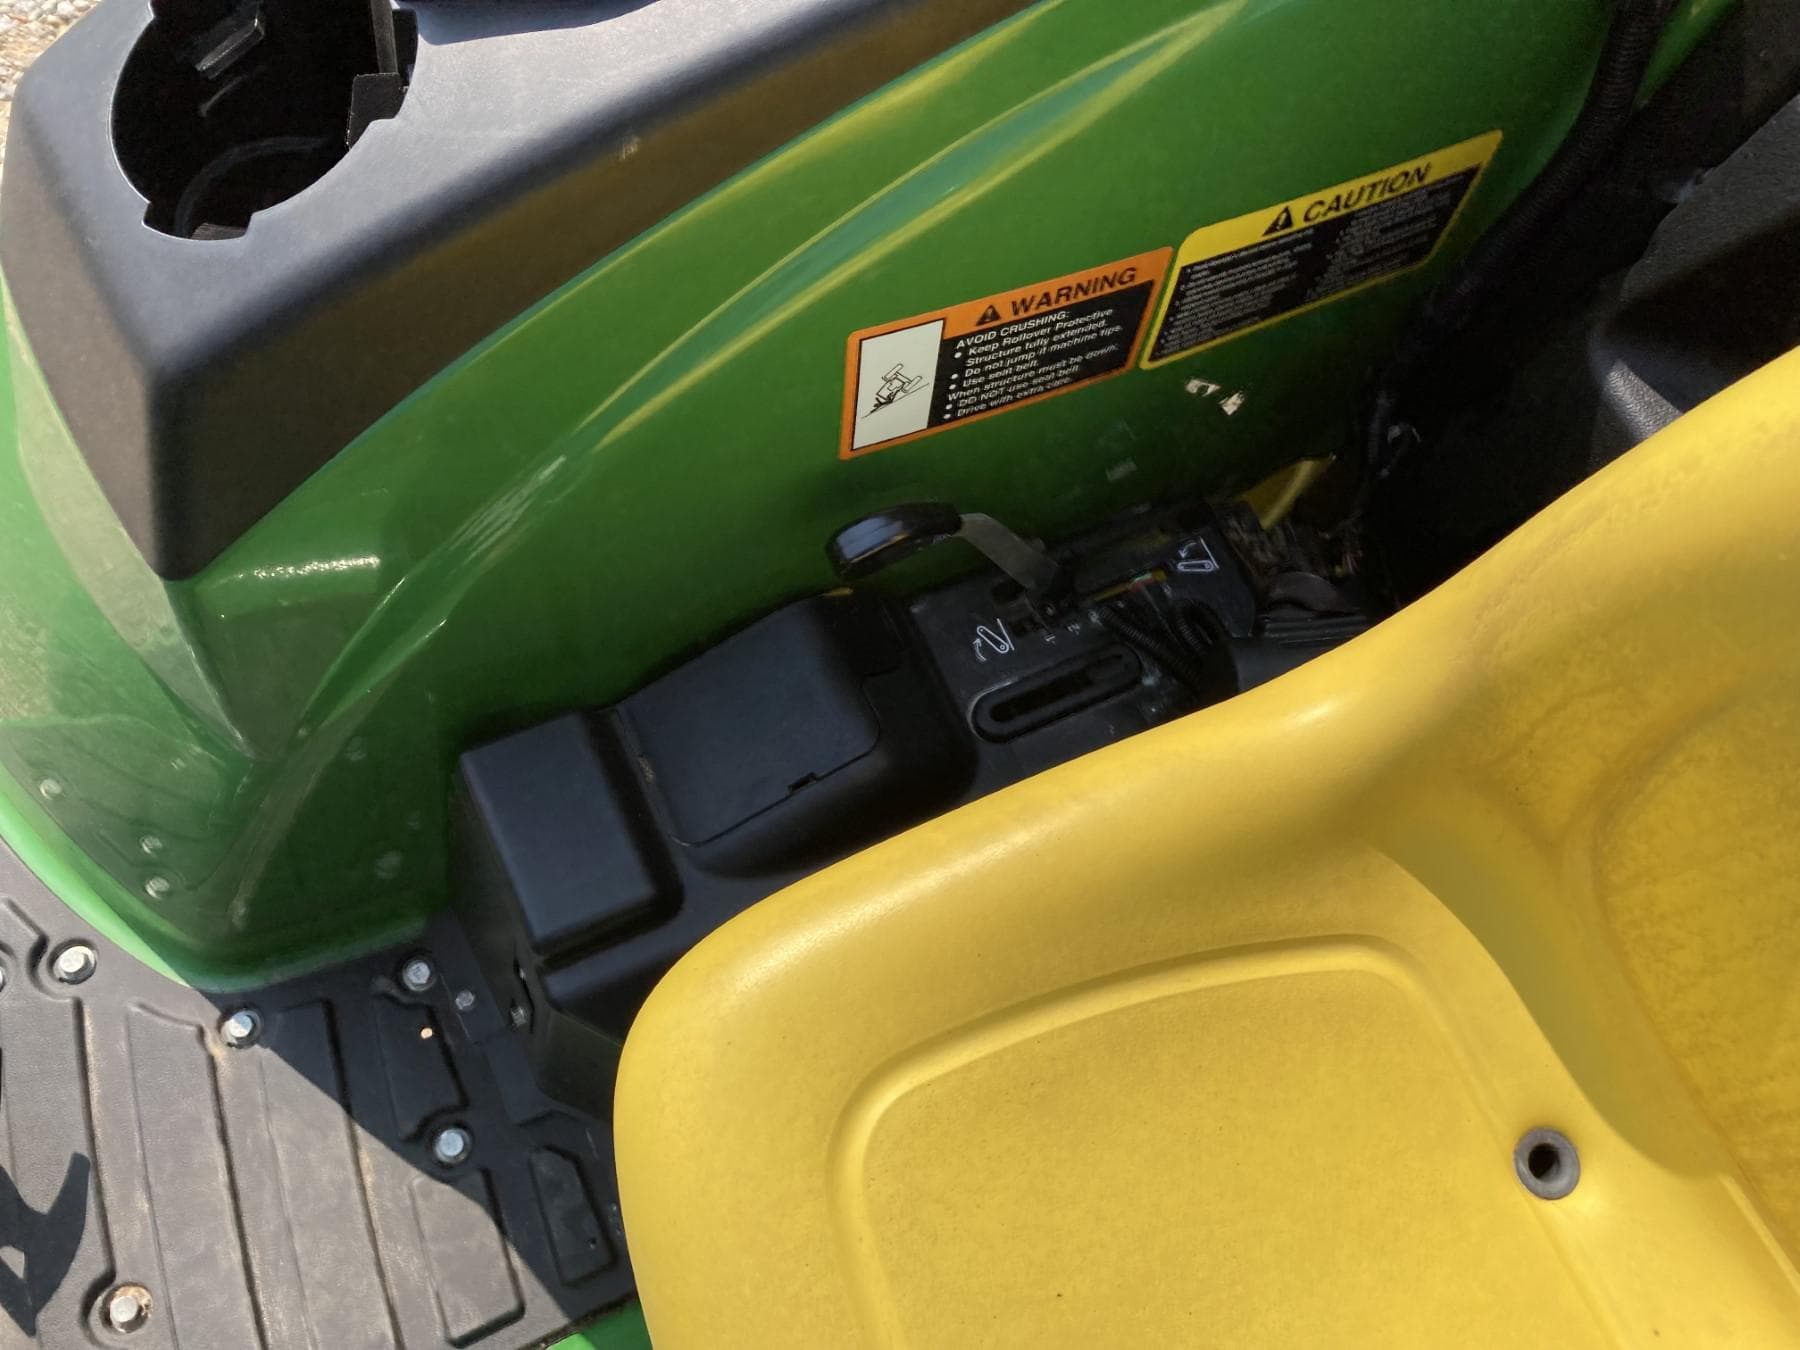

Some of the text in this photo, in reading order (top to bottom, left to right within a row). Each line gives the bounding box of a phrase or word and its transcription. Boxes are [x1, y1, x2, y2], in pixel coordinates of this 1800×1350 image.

[1303, 162, 1431, 222] CAUTION
[1011, 267, 1137, 316] WARNING
[956, 311, 1070, 349] AVOID CRUSHING:
[969, 309, 1114, 355] Keep Rollover Protective
[965, 368, 981, 377] Do
[985, 360, 1004, 371] not
[1006, 352, 1036, 367] jump
[1050, 333, 1098, 351] machine
[966, 346, 1022, 366] Structure
[1025, 337, 1050, 350] fully
[948, 387, 981, 401] When
[984, 370, 1036, 390] structure
[1038, 360, 1067, 374] must
[959, 396, 977, 407] DO
[980, 387, 1007, 401] NOT
[963, 377, 986, 387] Use
[957, 404, 987, 416] Drive
[990, 395, 1014, 407] with
